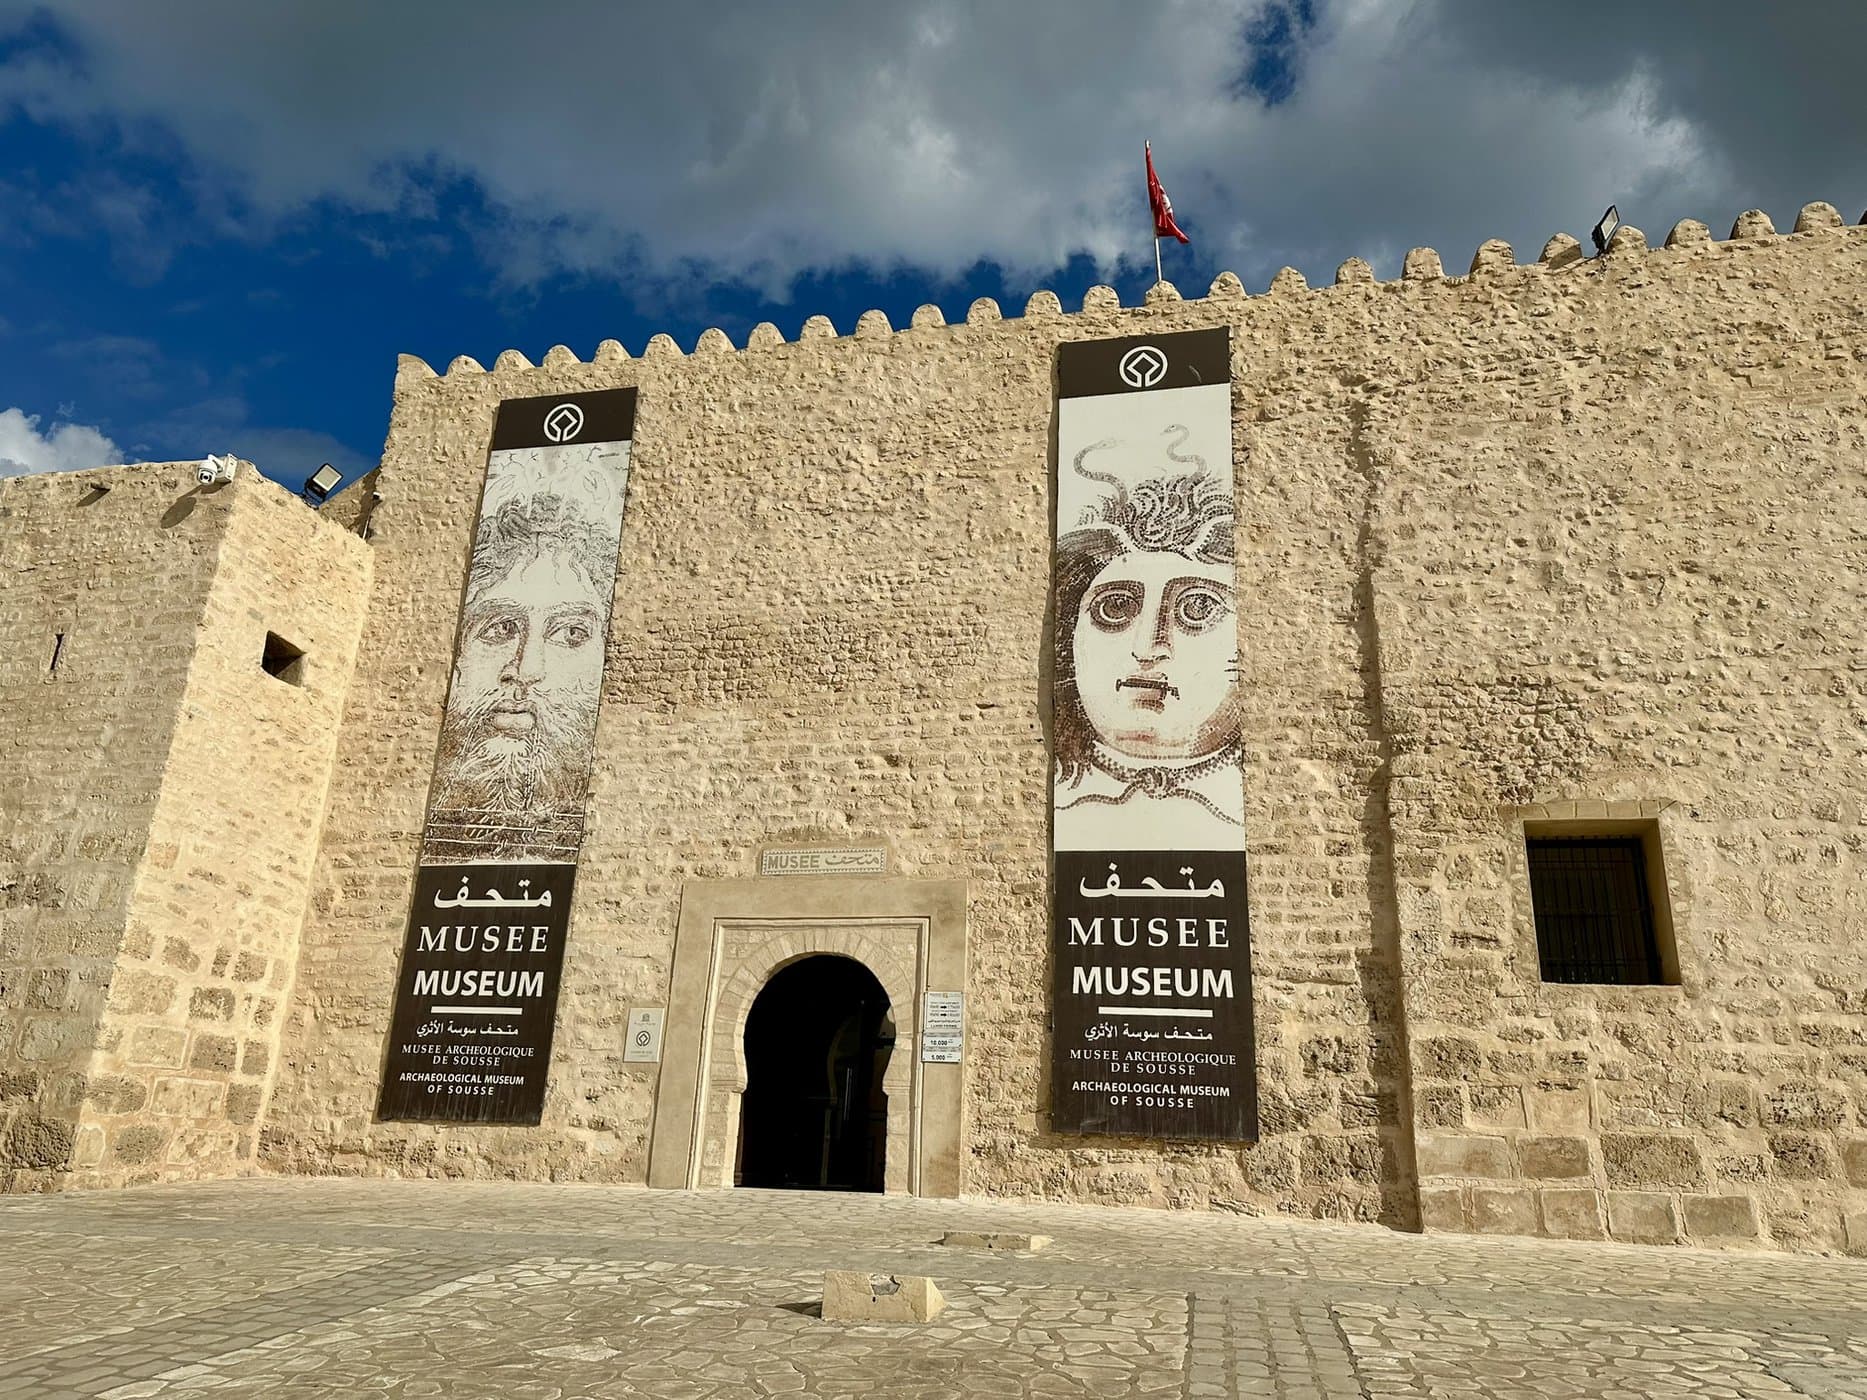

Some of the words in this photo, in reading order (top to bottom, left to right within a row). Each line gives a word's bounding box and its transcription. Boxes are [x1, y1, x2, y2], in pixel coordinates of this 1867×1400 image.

[767, 854, 821, 870] MUSEE
[824, 852, 880, 866] متحف
[1079, 862, 1225, 898] متحف
[433, 875, 553, 909] متحف
[416, 925, 550, 953] MUSEE
[1067, 917, 1230, 948] MUSEE
[412, 970, 545, 998] MUSEUM
[1072, 966, 1234, 999] MUSEUM
[416, 1019, 444, 1038] الأثري
[447, 1020, 477, 1038] سوسة
[479, 1022, 519, 1036] متحف
[1084, 1021, 1118, 1042] الأثري
[1122, 1022, 1160, 1042] سوسة
[1163, 1026, 1213, 1041] متحف
[401, 1044, 442, 1055] MUSEE
[445, 1045, 535, 1058] ARCHEOLOGIQUE
[1069, 1048, 1120, 1061] MUSEE
[1124, 1051, 1237, 1066] ARCHEOLOGIQUE
[432, 1055, 449, 1065] DE
[452, 1056, 501, 1067] SOUSSE
[1110, 1062, 1131, 1074] DE
[1136, 1063, 1196, 1076] SOUSSE
[399, 1072, 482, 1084] ARCHAEOLOGICAL
[484, 1074, 525, 1086] MUSEUM
[427, 1084, 443, 1094] OF
[447, 1085, 495, 1096] SOUSSE
[1071, 1080, 1177, 1095] ARCHAEOLOGICAL
[1179, 1084, 1231, 1097] MUSEUM
[1110, 1095, 1129, 1106] OF
[1135, 1096, 1195, 1109] SOUSSE
